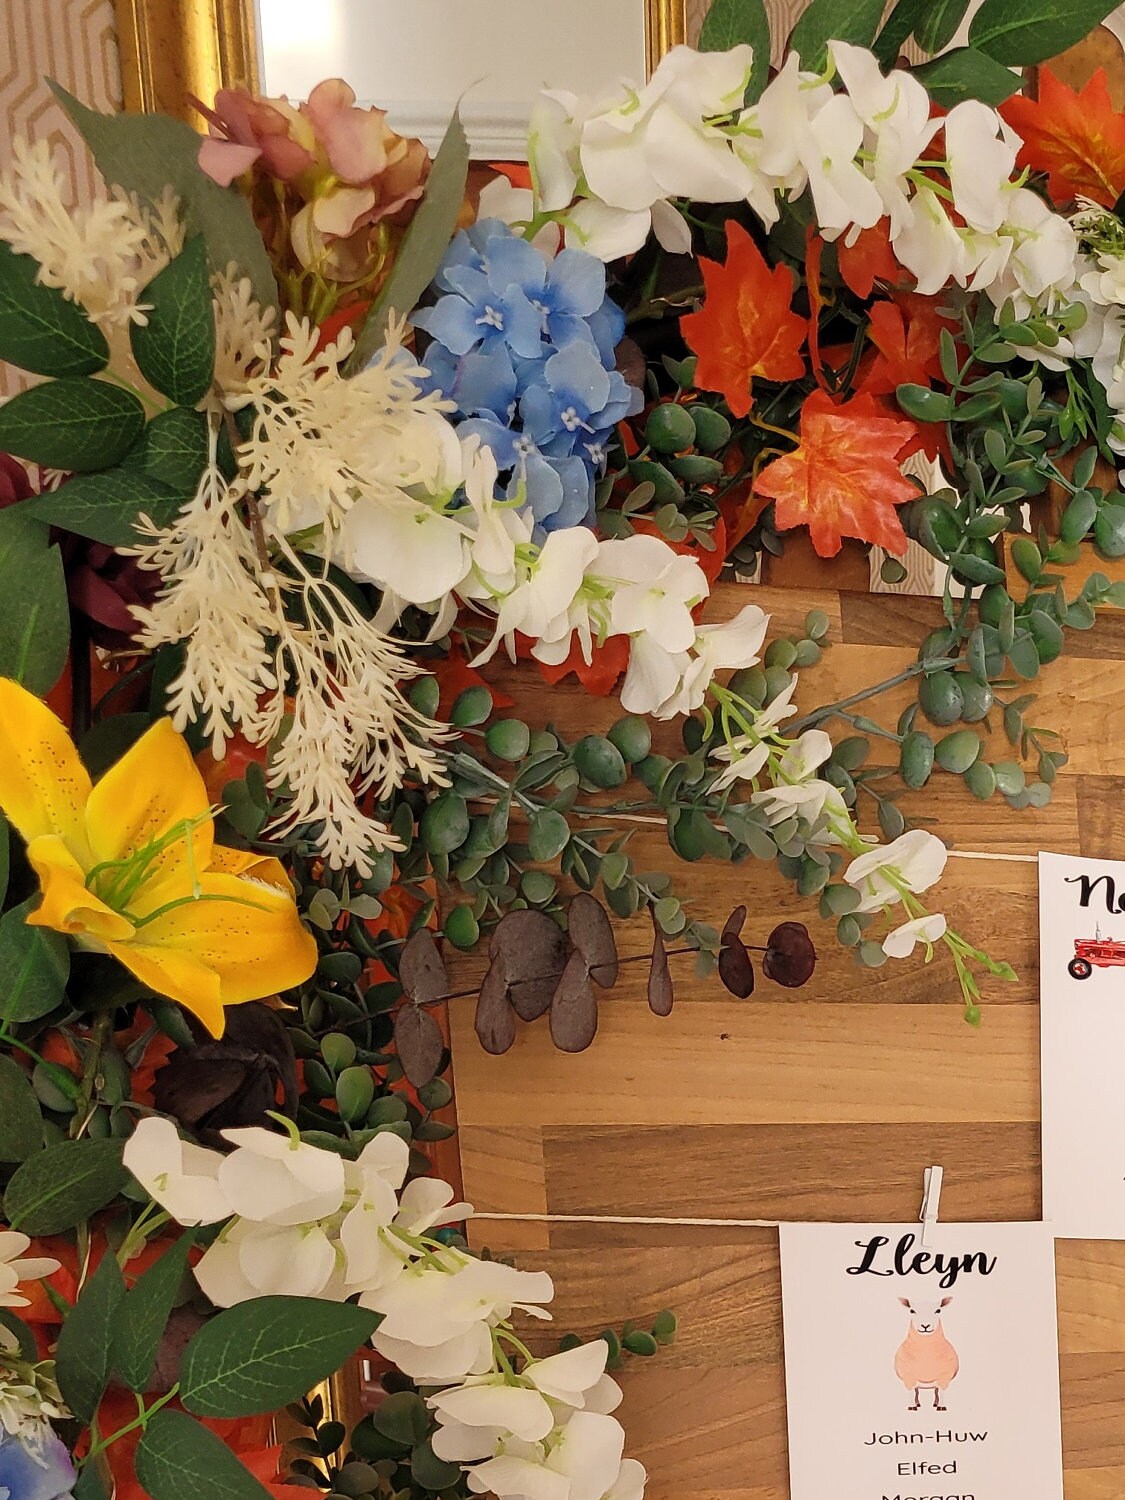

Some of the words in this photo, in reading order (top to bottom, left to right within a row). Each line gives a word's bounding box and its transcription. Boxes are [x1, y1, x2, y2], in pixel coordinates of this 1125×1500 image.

[845, 1233, 998, 1289] Lleyn
[864, 1429, 988, 1446] John-Huw
[897, 1460, 957, 1476] Elfed
